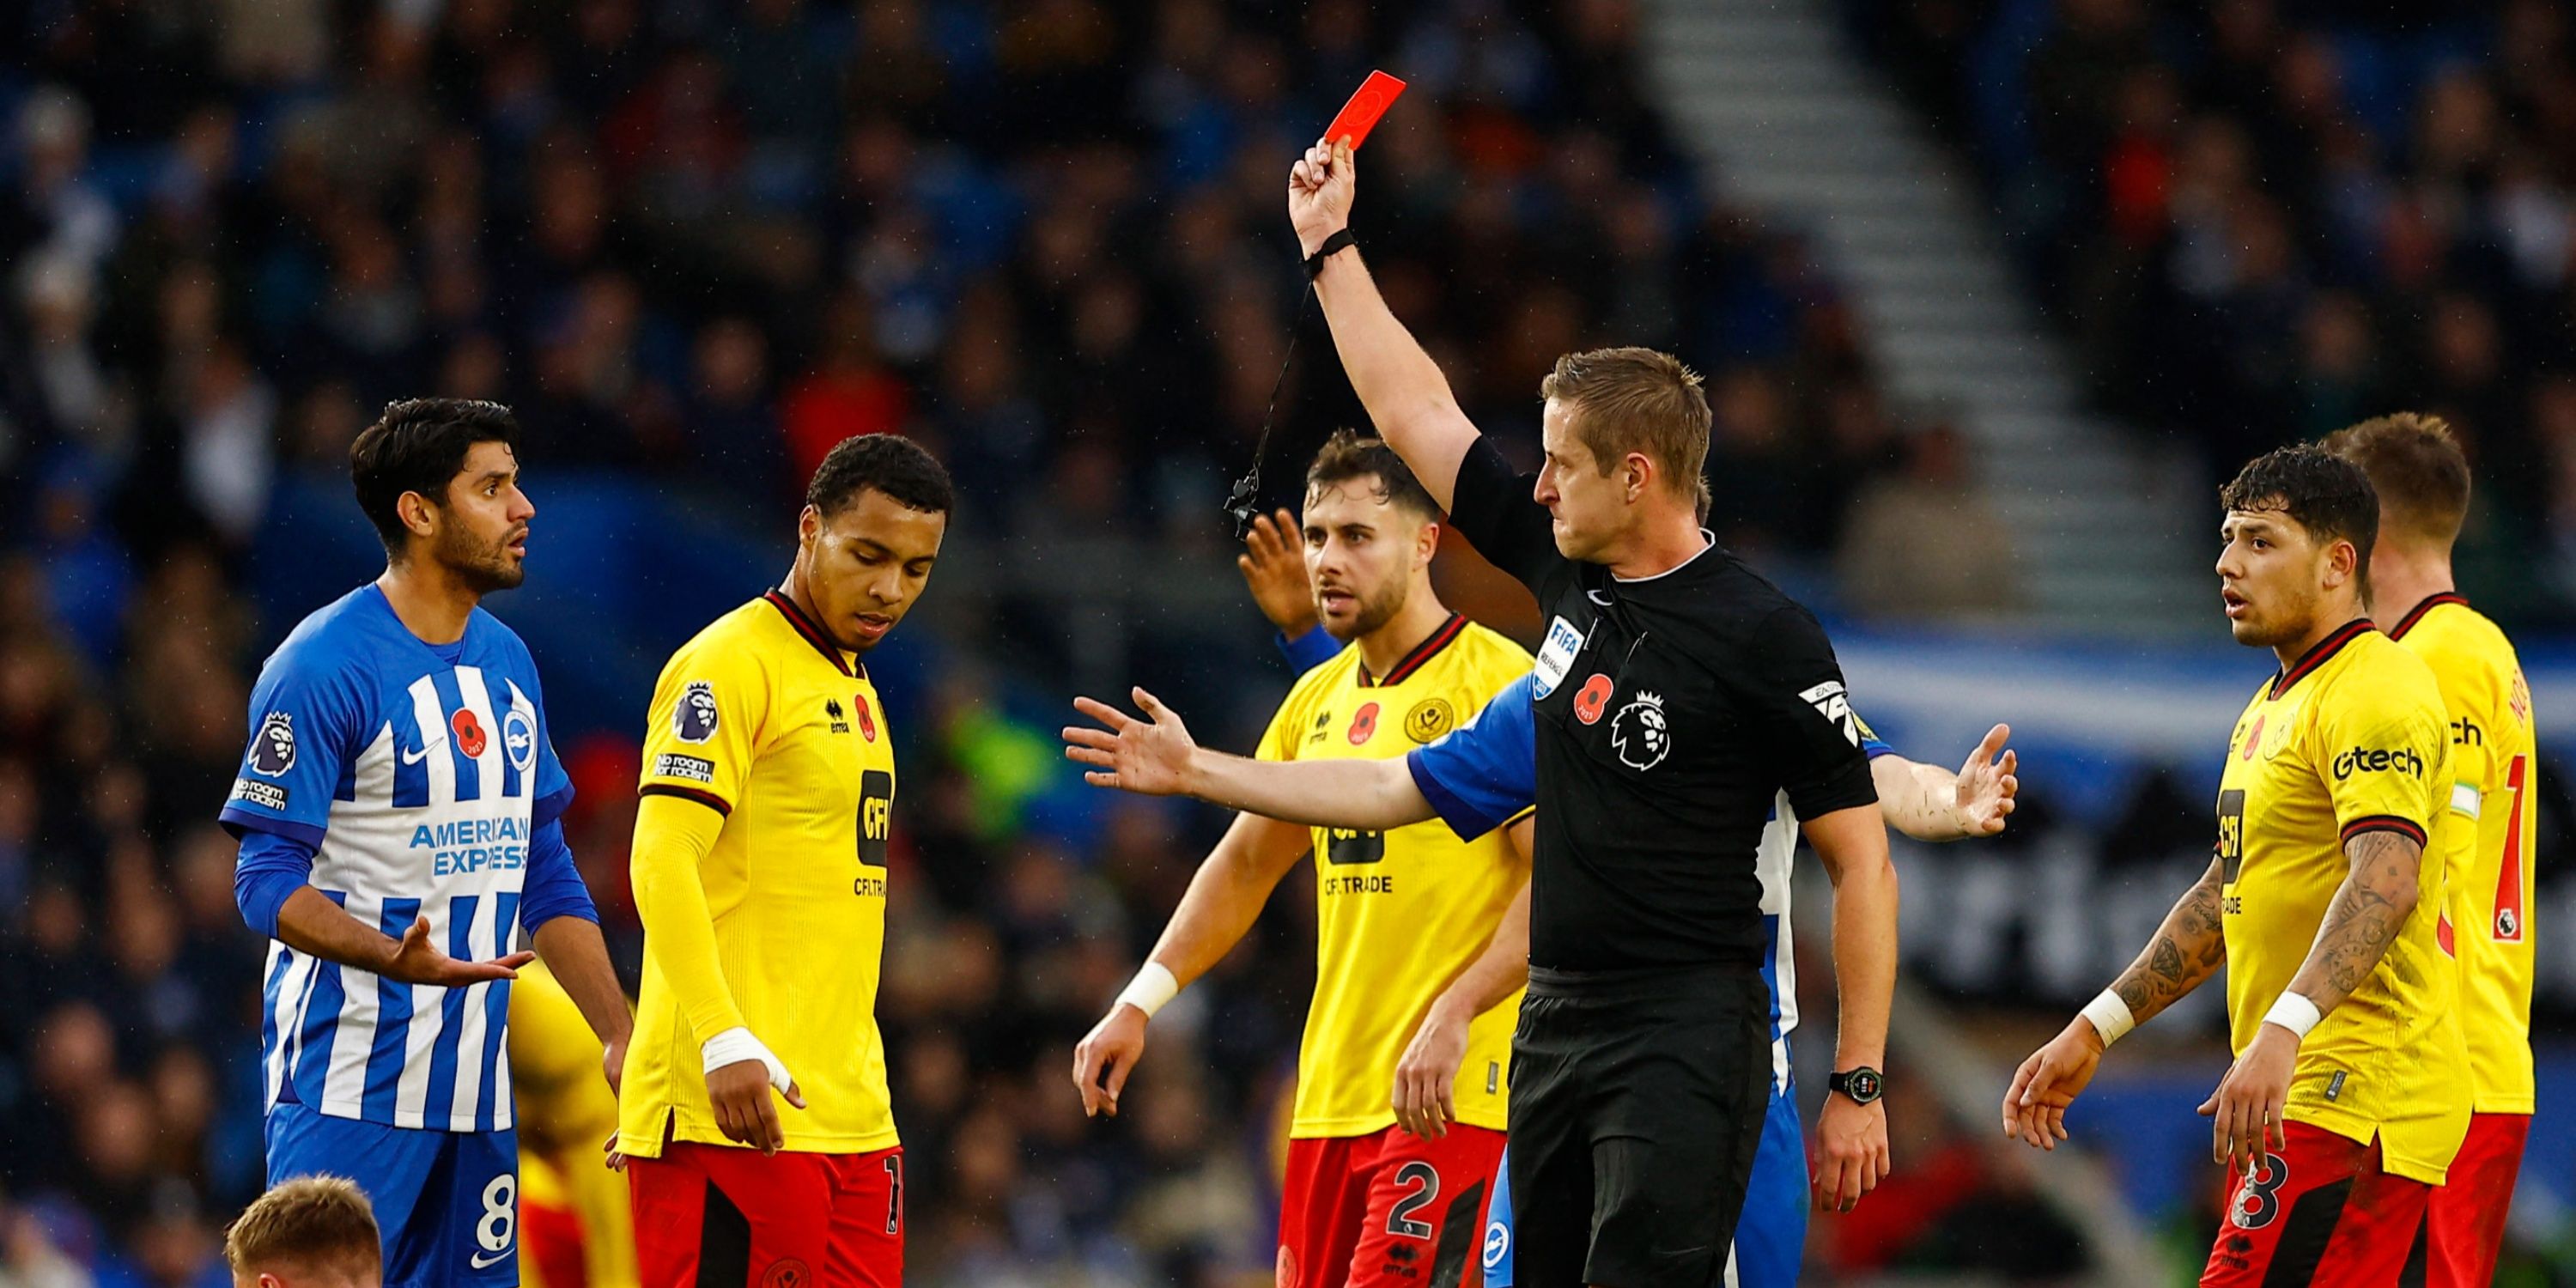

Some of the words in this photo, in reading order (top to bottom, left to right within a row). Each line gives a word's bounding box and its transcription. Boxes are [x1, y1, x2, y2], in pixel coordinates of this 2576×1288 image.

[1551, 623, 1577, 656] FIFA
[1578, 705, 1594, 720] 2023
[467, 740, 483, 755] 2023
[656, 754, 672, 765] No
[672, 756, 709, 773] room
[2333, 746, 2423, 781] Gtech
[249, 781, 283, 800] room
[670, 767, 713, 783] racism
[246, 791, 286, 811] racism
[863, 796, 890, 841] CFI
[2219, 815, 2239, 858] CFI
[1386, 1160, 1440, 1241] 2
[2230, 1152, 2288, 1230] 8
[476, 1173, 516, 1252] 8
